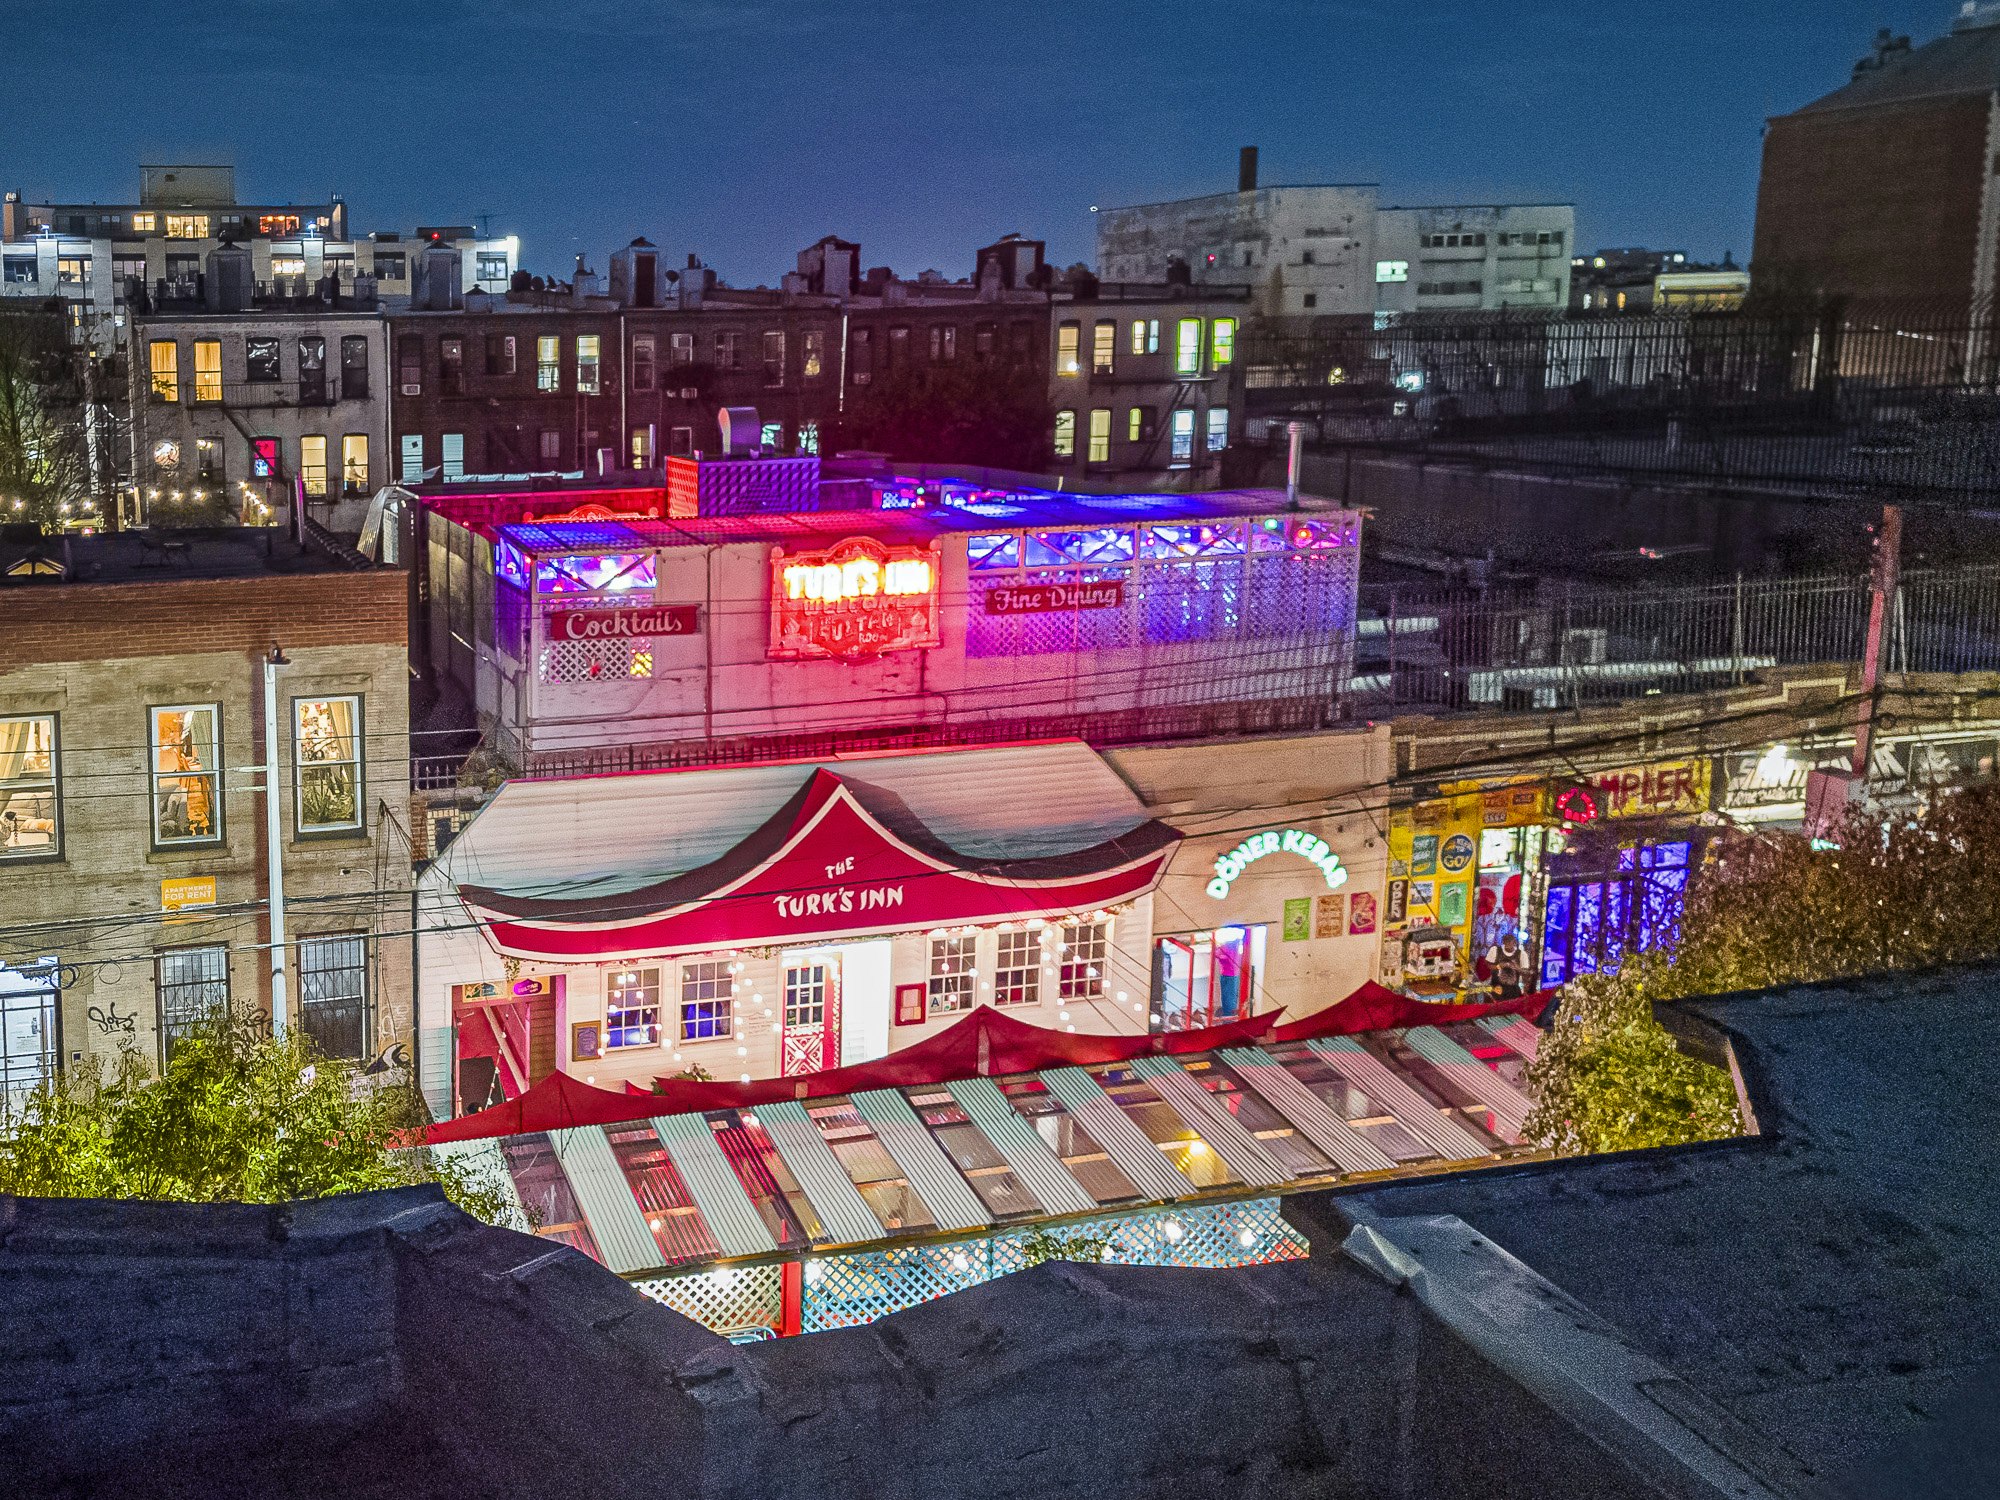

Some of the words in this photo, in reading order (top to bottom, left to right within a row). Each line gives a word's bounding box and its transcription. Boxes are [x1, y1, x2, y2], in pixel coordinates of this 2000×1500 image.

[994, 589, 1042, 611] Fine
[1046, 585, 1117, 608] Dining
[566, 611, 683, 639] Cocktails
[1599, 767, 1698, 808] MPLER
[825, 856, 854, 879] THE
[187, 891, 212, 899] RENT
[773, 887, 854, 918] TURK'S
[860, 885, 903, 910] INN
[931, 997, 940, 1008] A
